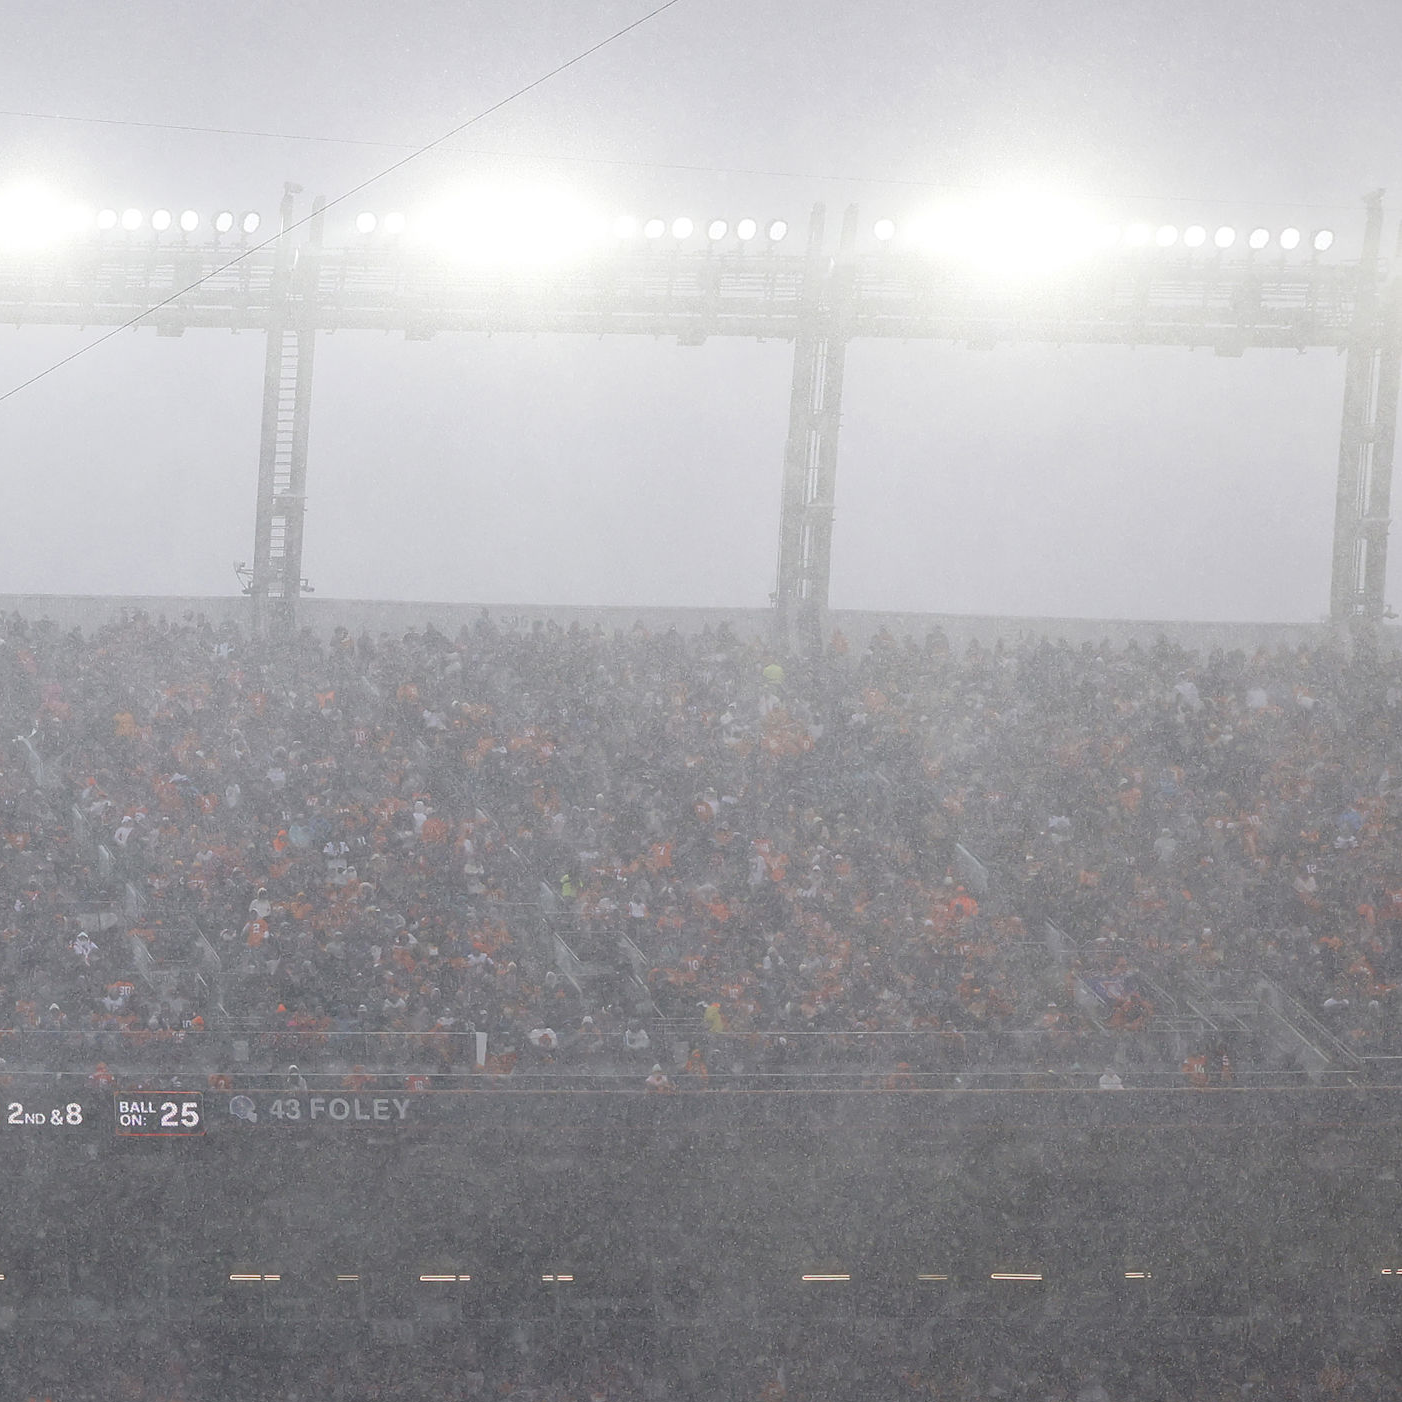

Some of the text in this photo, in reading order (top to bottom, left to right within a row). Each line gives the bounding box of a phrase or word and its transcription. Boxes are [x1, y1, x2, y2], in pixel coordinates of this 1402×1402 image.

[119, 1101, 156, 1113] BALL
[160, 1102, 200, 1127] 25
[269, 1098, 412, 1121] 43 FOLEY
[120, 1114, 147, 1126] ON:
